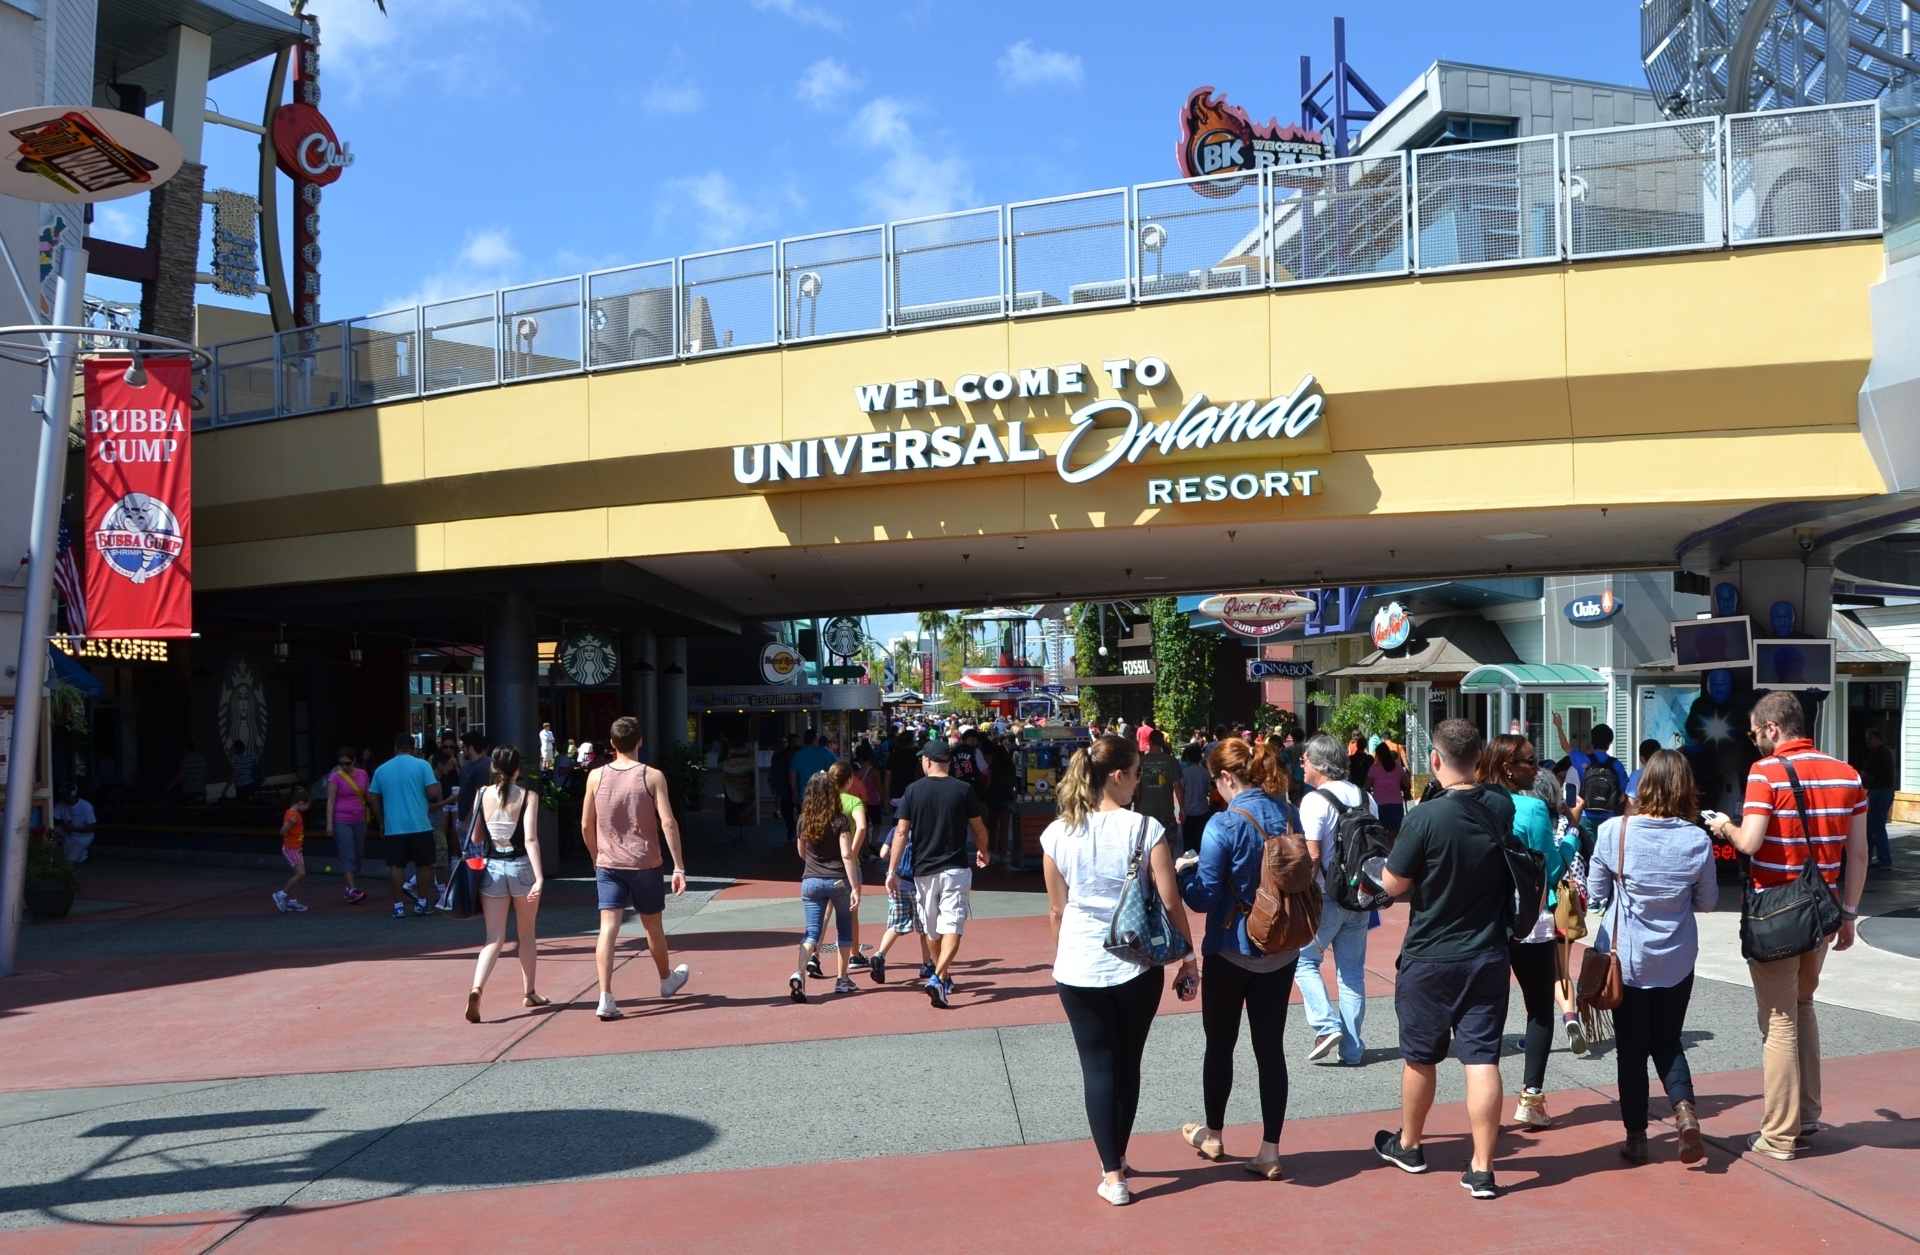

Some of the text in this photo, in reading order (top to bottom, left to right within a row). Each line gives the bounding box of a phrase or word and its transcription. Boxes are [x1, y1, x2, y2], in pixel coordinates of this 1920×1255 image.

[92, 135, 130, 164] UNIVERSAL
[297, 132, 355, 175] Club
[1204, 140, 1244, 173] BK
[1252, 140, 1322, 155] WHOPPER
[51, 146, 135, 191] WALK
[1254, 150, 1323, 177] BAR
[853, 356, 1169, 412] WELCOME TO
[90, 409, 185, 433] BUBBA
[732, 374, 1325, 484] UNIVERSAL Orlando
[99, 438, 178, 463] GUMP
[1148, 469, 1319, 504] RESORT
[98, 533, 181, 553] BUBBA GUMP
[110, 549, 142, 557] SHRIMP
[1223, 596, 1298, 616] Quiet Flight
[1572, 601, 1601, 617] Clubs
[1232, 620, 1286, 634] SURF SHOP
[111, 638, 168, 661] COFFEE
[764, 656, 802, 667] Hard Rock
[1122, 659, 1151, 676] FOSSIL
[1250, 662, 1314, 677] CINNABON
[726, 693, 750, 705] DINING
[751, 694, 802, 706] RESERVATIONS
[953, 760, 973, 778] 23
